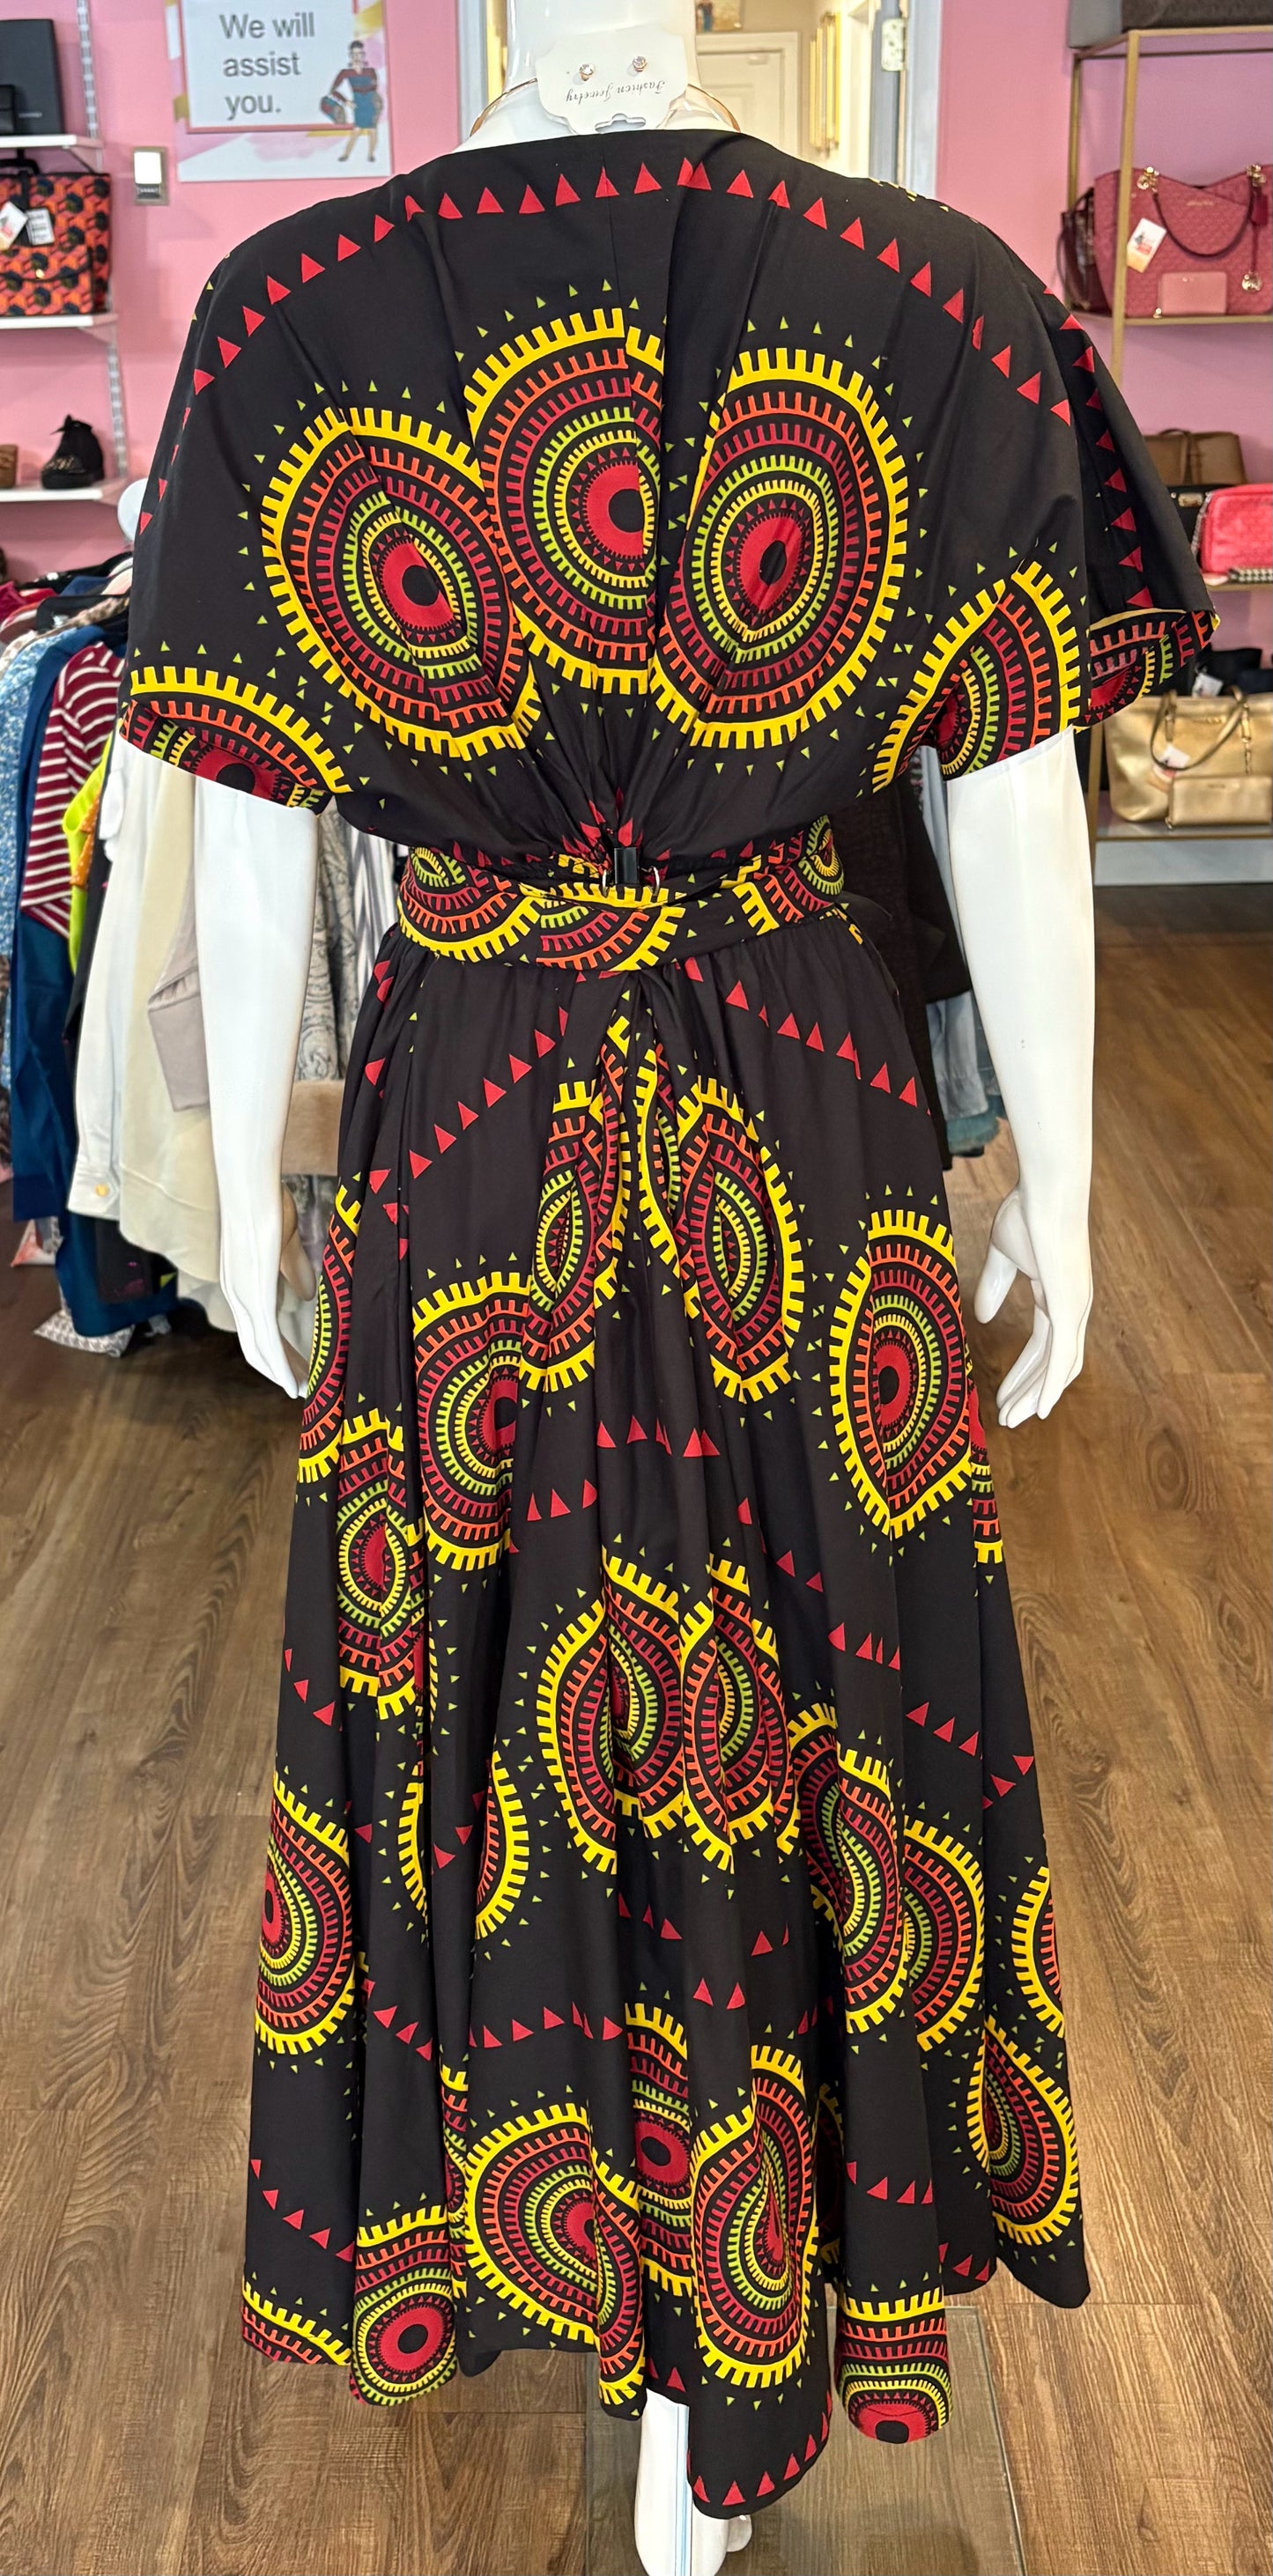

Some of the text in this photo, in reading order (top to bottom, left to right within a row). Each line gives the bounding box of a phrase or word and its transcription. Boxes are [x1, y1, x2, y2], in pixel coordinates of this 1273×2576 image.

[218, 11, 315, 40] We will
[222, 50, 302, 78] assist
[566, 80, 666, 105] Fashion Jewelry
[224, 94, 282, 122] you.
